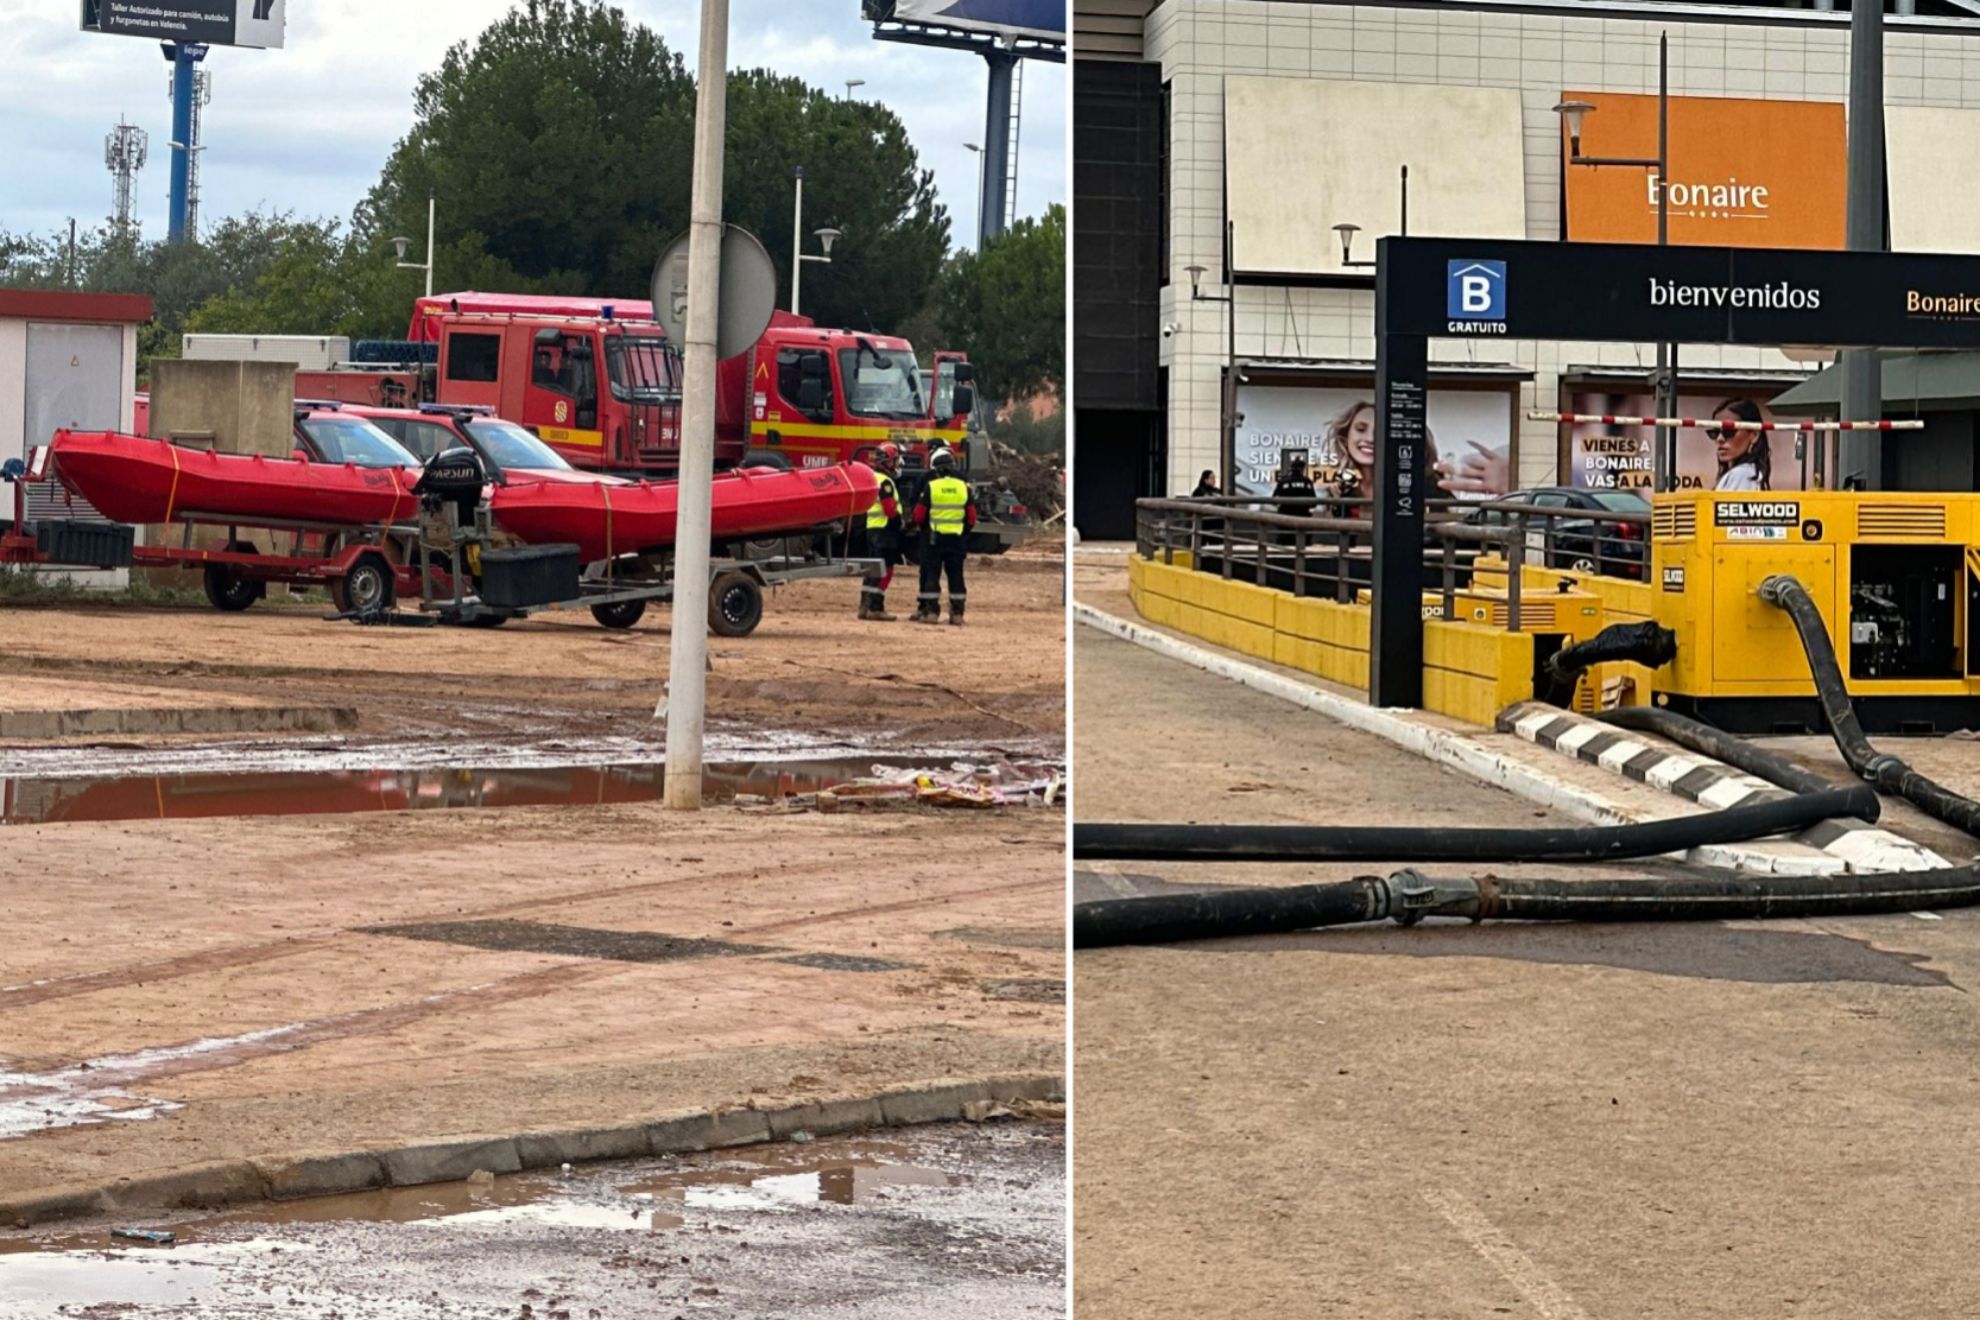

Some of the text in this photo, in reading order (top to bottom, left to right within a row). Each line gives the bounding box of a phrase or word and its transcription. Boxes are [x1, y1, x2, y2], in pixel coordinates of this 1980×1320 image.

[111, 2, 128, 12] Taller
[129, 5, 163, 15] Autorizado
[163, 10, 178, 18] para
[110, 16, 115, 24] y
[116, 15, 150, 26] furgonetas
[1462, 276, 1492, 312] B
[1649, 278, 1820, 309] bienvenidos
[1907, 291, 1980, 313] Bonaire
[1448, 321, 1507, 334] GRATUITO
[1250, 433, 1320, 447] BONAIRE
[1583, 440, 1650, 453] VIENES A
[1320, 453, 1338, 467] ES
[1585, 457, 1656, 472] BONAIRE,
[1250, 469, 1271, 483] UN
[1585, 475, 1615, 488] VAS
[1619, 475, 1630, 489] A
[1634, 475, 1653, 489] LA
[1717, 503, 1798, 518] SELWOOD
